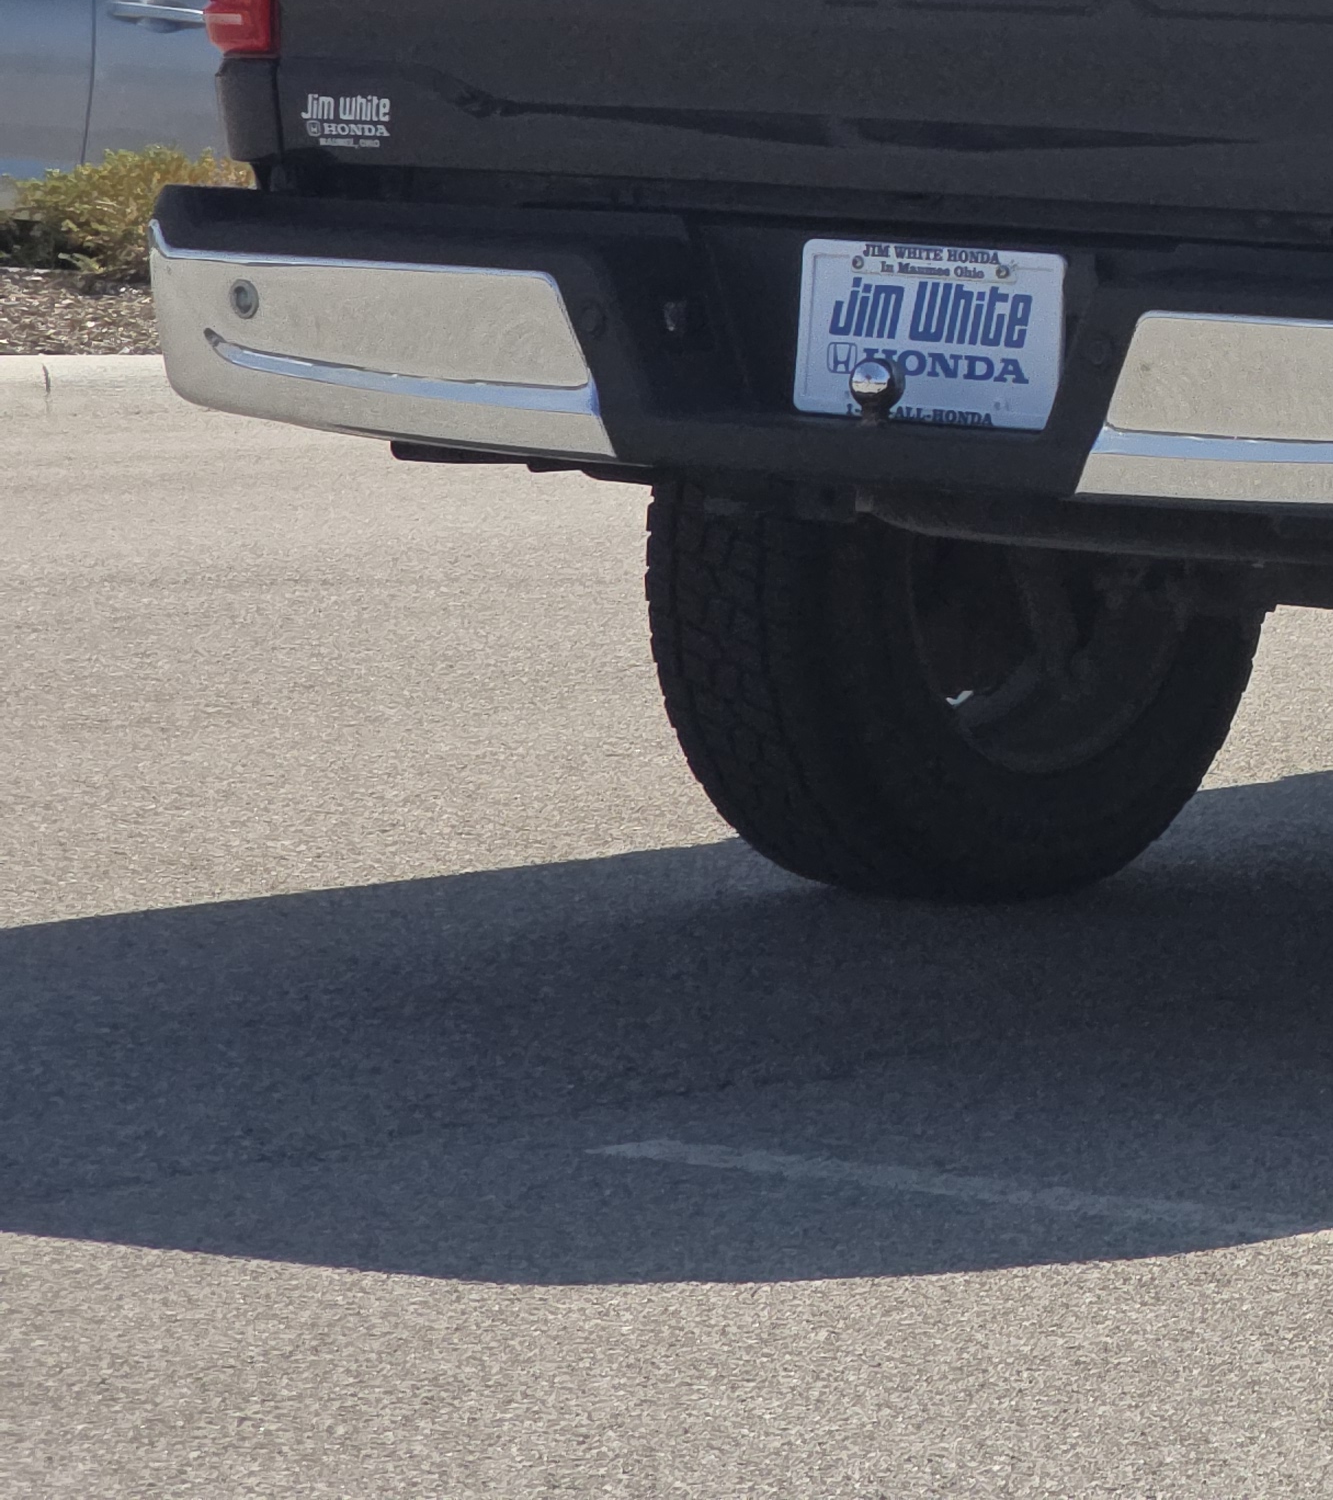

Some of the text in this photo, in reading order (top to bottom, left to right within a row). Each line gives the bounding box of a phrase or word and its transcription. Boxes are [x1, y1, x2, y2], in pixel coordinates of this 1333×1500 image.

[300, 93, 335, 120] Jim
[323, 123, 390, 136] HONDA
[863, 244, 1001, 265] JIM WHITE HONDA
[880, 261, 894, 273] In
[953, 265, 985, 279] Ohio
[909, 281, 1032, 348] White
